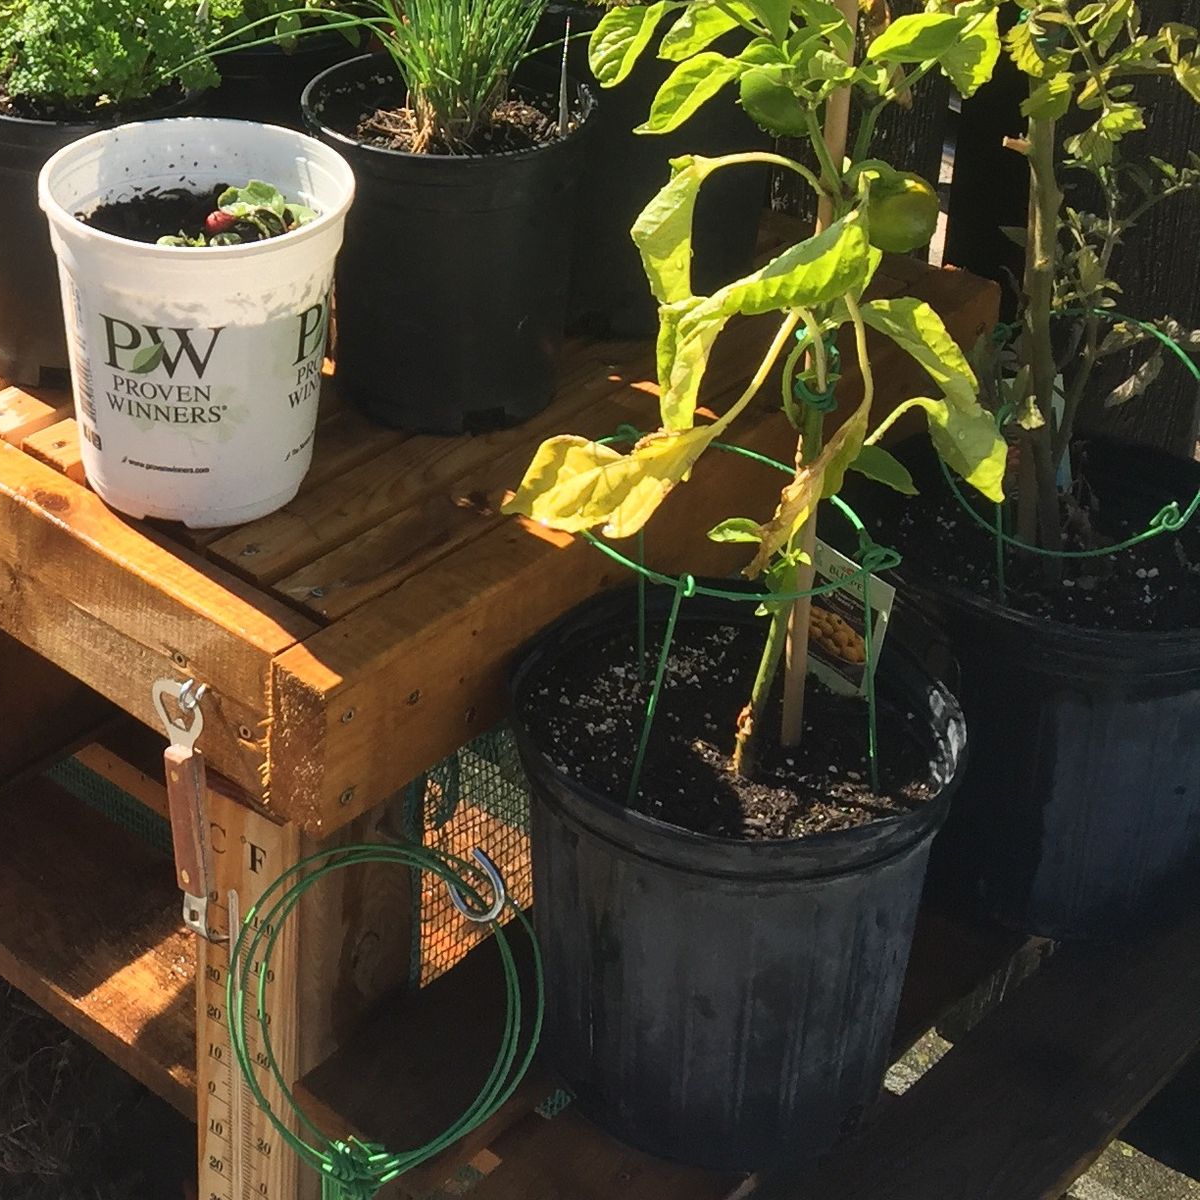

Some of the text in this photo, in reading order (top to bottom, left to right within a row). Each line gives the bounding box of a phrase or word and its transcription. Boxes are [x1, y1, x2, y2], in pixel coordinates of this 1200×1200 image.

[99, 313, 227, 379] PW
[112, 374, 212, 402] PROVEN
[207, 1004, 221, 1020] 20
[208, 1043, 222, 1060] 10
[256, 1052, 272, 1069] 60
[208, 1080, 216, 1093] 0
[209, 1119, 223, 1136] 10
[257, 1137, 272, 1155] 20
[209, 1155, 223, 1173] 20
[259, 1183, 268, 1196] 0
